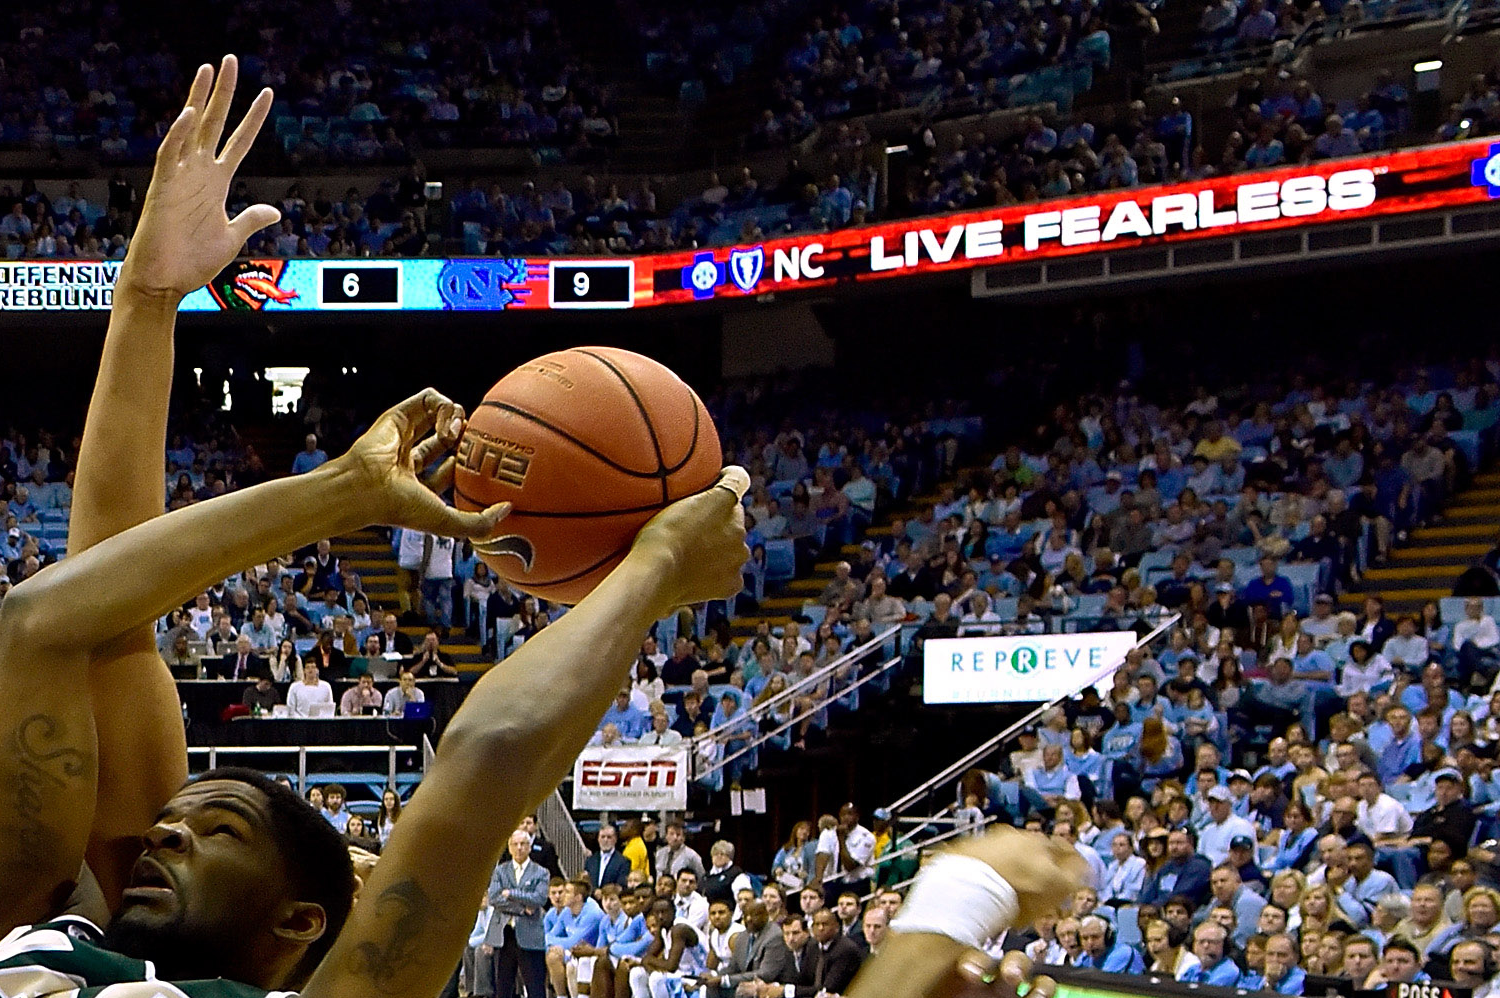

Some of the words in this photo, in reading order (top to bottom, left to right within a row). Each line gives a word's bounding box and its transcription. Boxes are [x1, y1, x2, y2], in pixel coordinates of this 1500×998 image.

[775, 243, 825, 282] NC
[870, 219, 1003, 272] LIVE
[1024, 168, 1376, 251] FEARLESS
[342, 273, 360, 297] 6
[573, 272, 591, 296] 9
[952, 646, 1102, 673] REPREVE
[581, 760, 678, 787] ESPN
